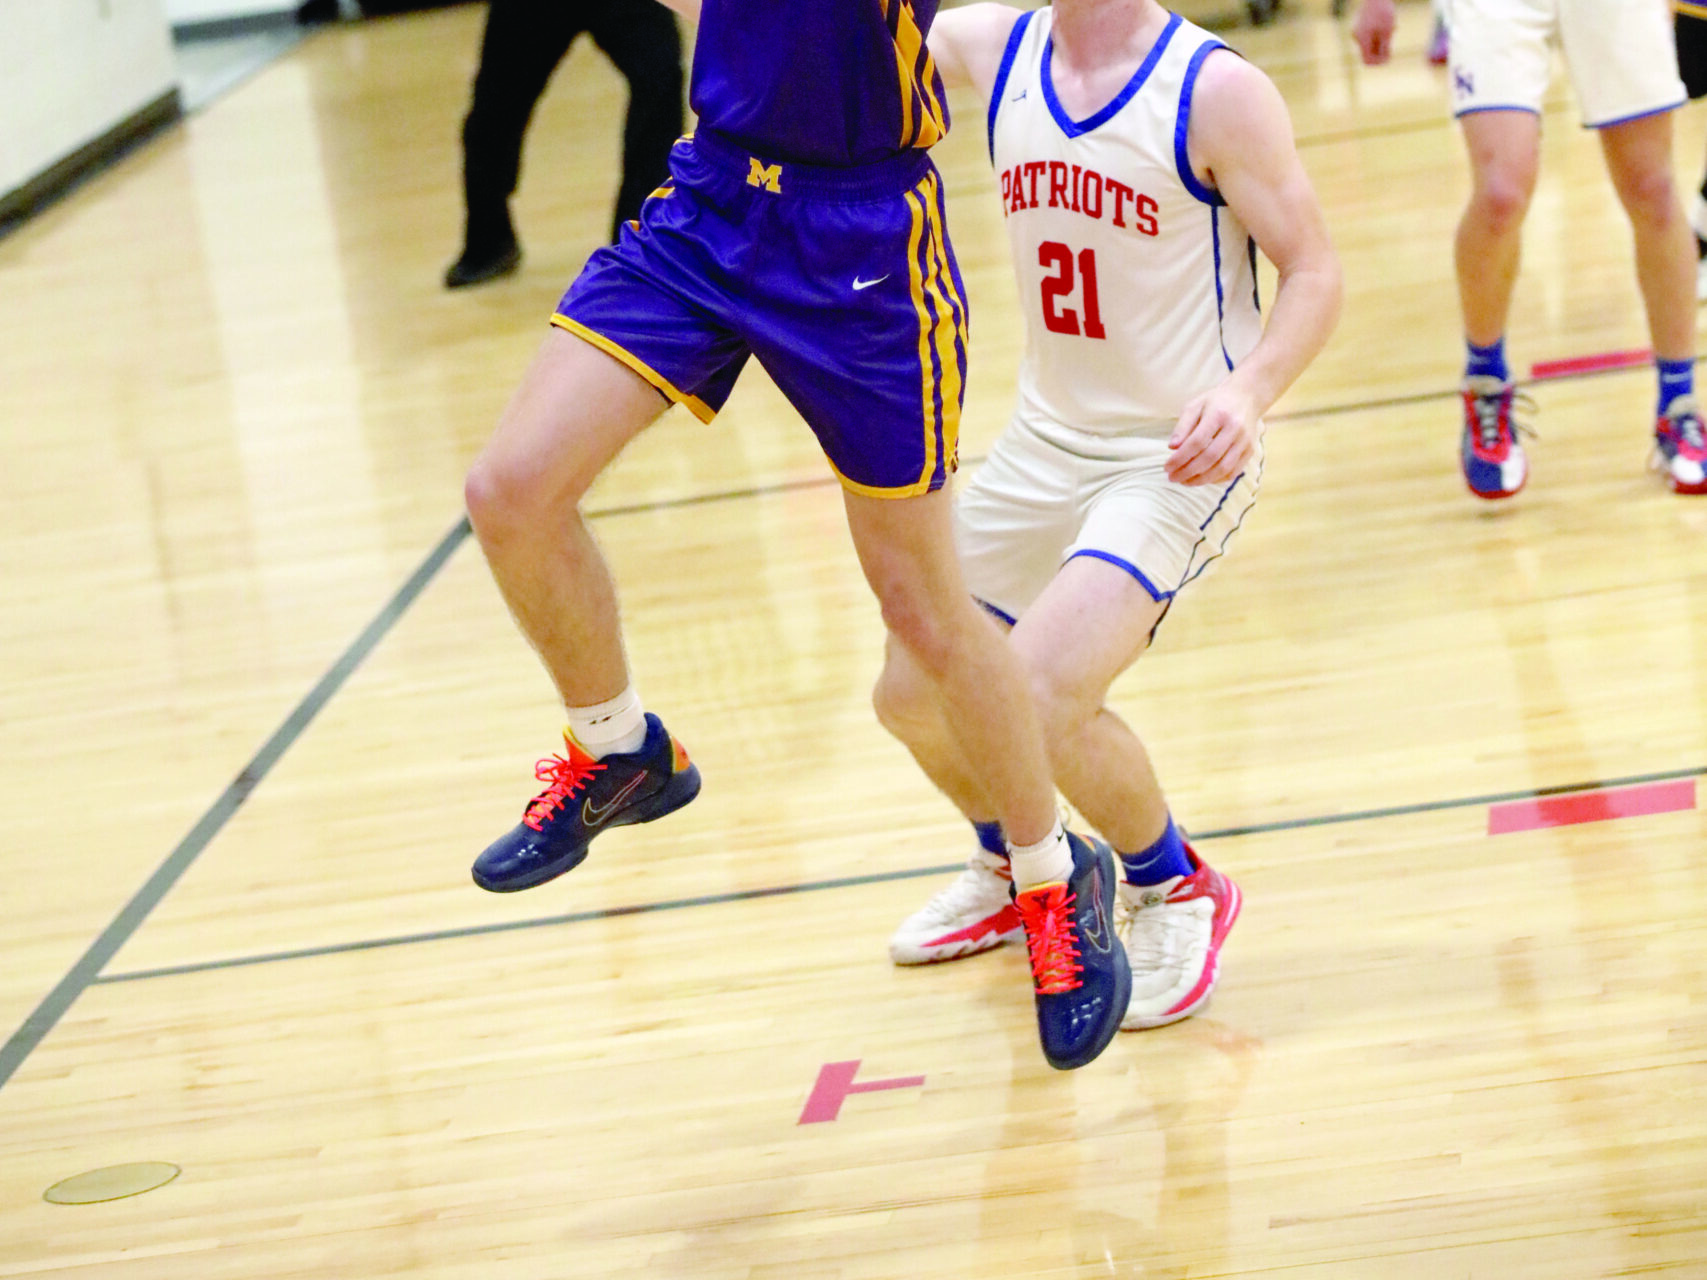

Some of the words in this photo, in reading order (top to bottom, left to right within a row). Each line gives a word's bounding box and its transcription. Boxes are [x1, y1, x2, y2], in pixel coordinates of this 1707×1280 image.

[746, 156, 783, 194] M
[1001, 160, 1160, 237] PATRIOTS
[1037, 240, 1107, 341] 21
